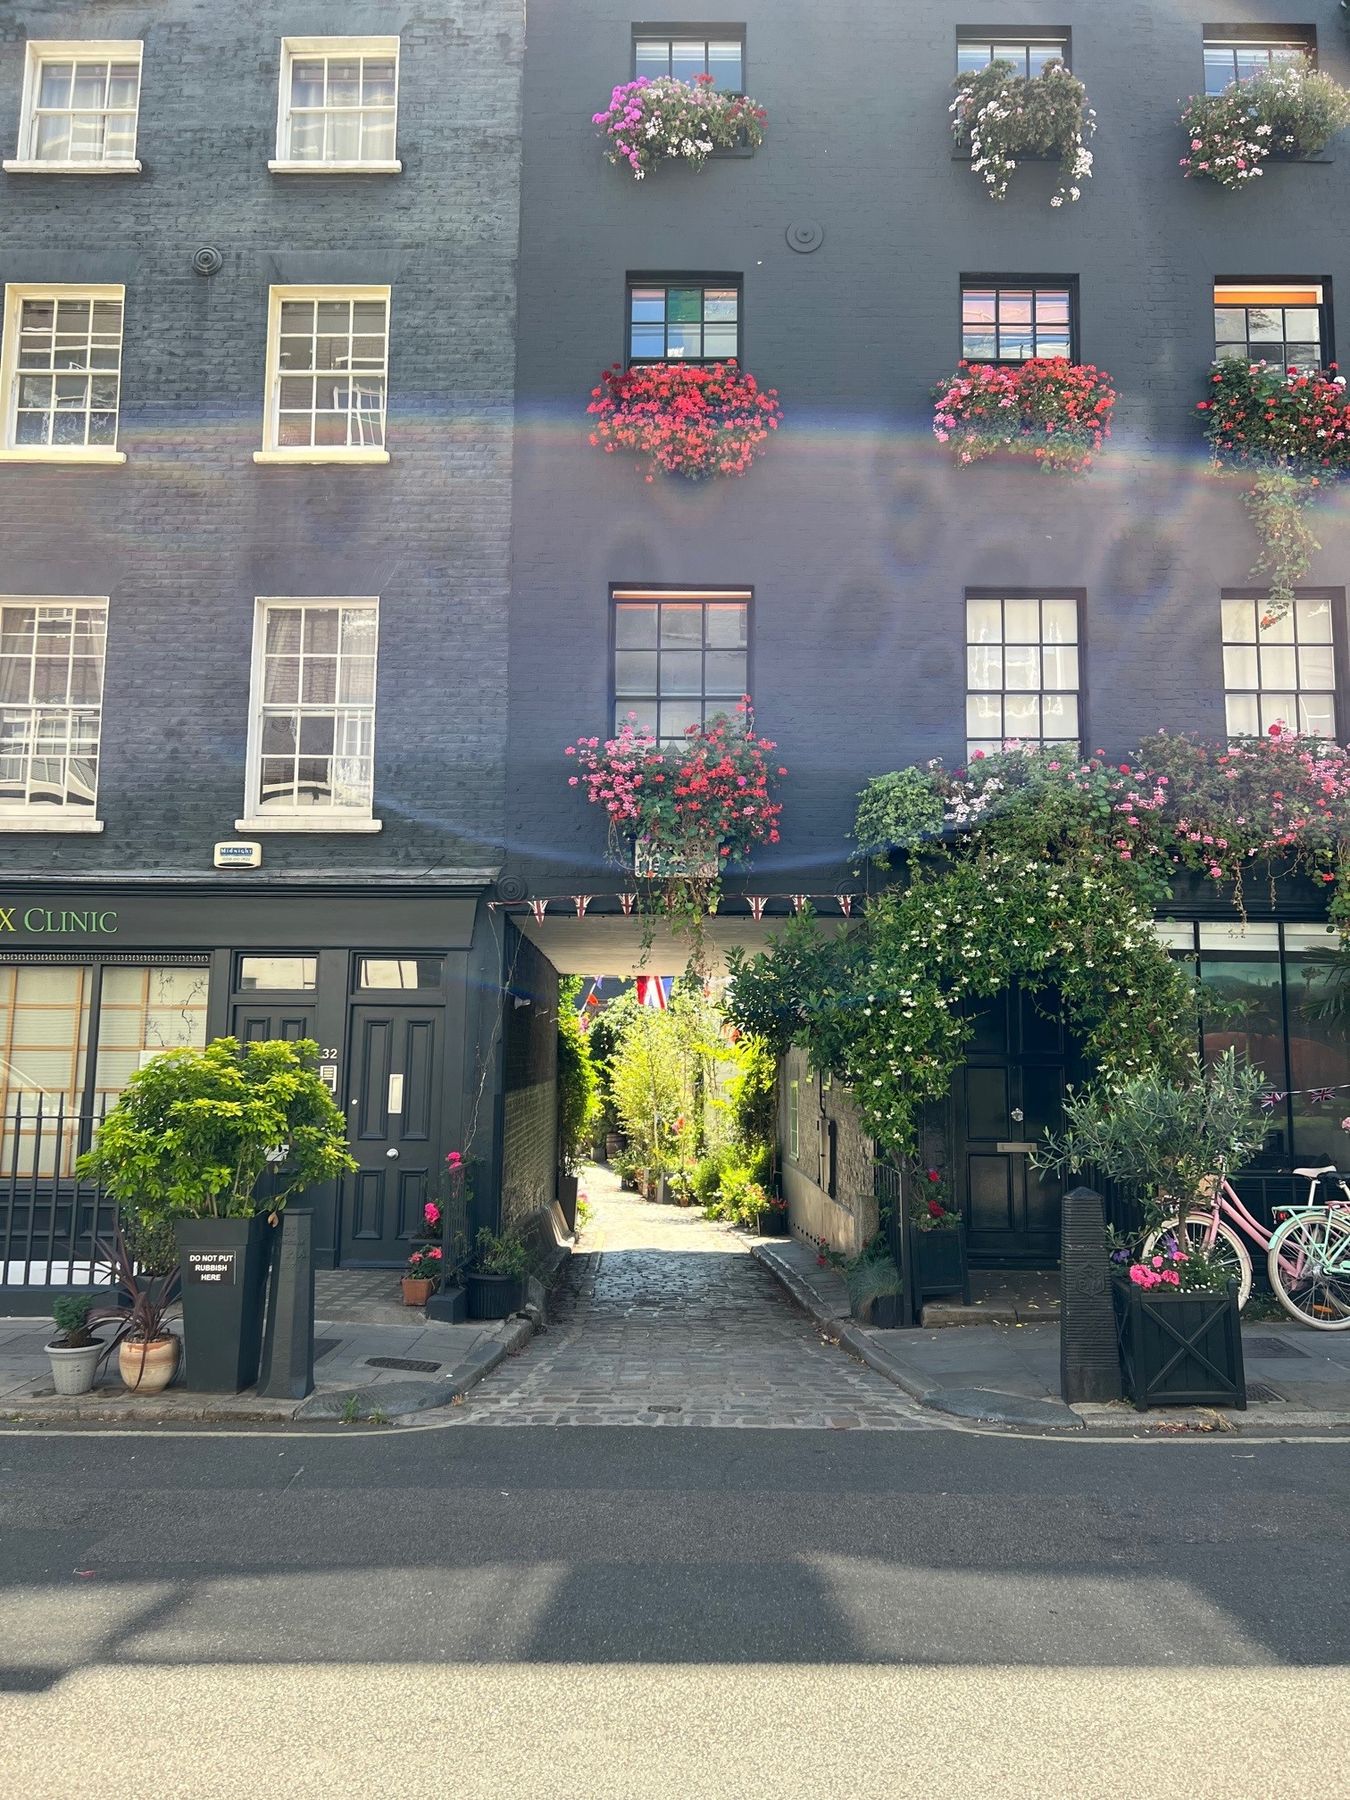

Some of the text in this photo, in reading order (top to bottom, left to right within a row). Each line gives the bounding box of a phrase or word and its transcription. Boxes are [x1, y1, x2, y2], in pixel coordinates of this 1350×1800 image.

[24, 907, 119, 933] CLINIC
[322, 1048, 338, 1059] 32
[189, 1254, 233, 1262] DO NOT PUT
[194, 1264, 228, 1272] RUBBISH
[200, 1273, 221, 1281] HERE
